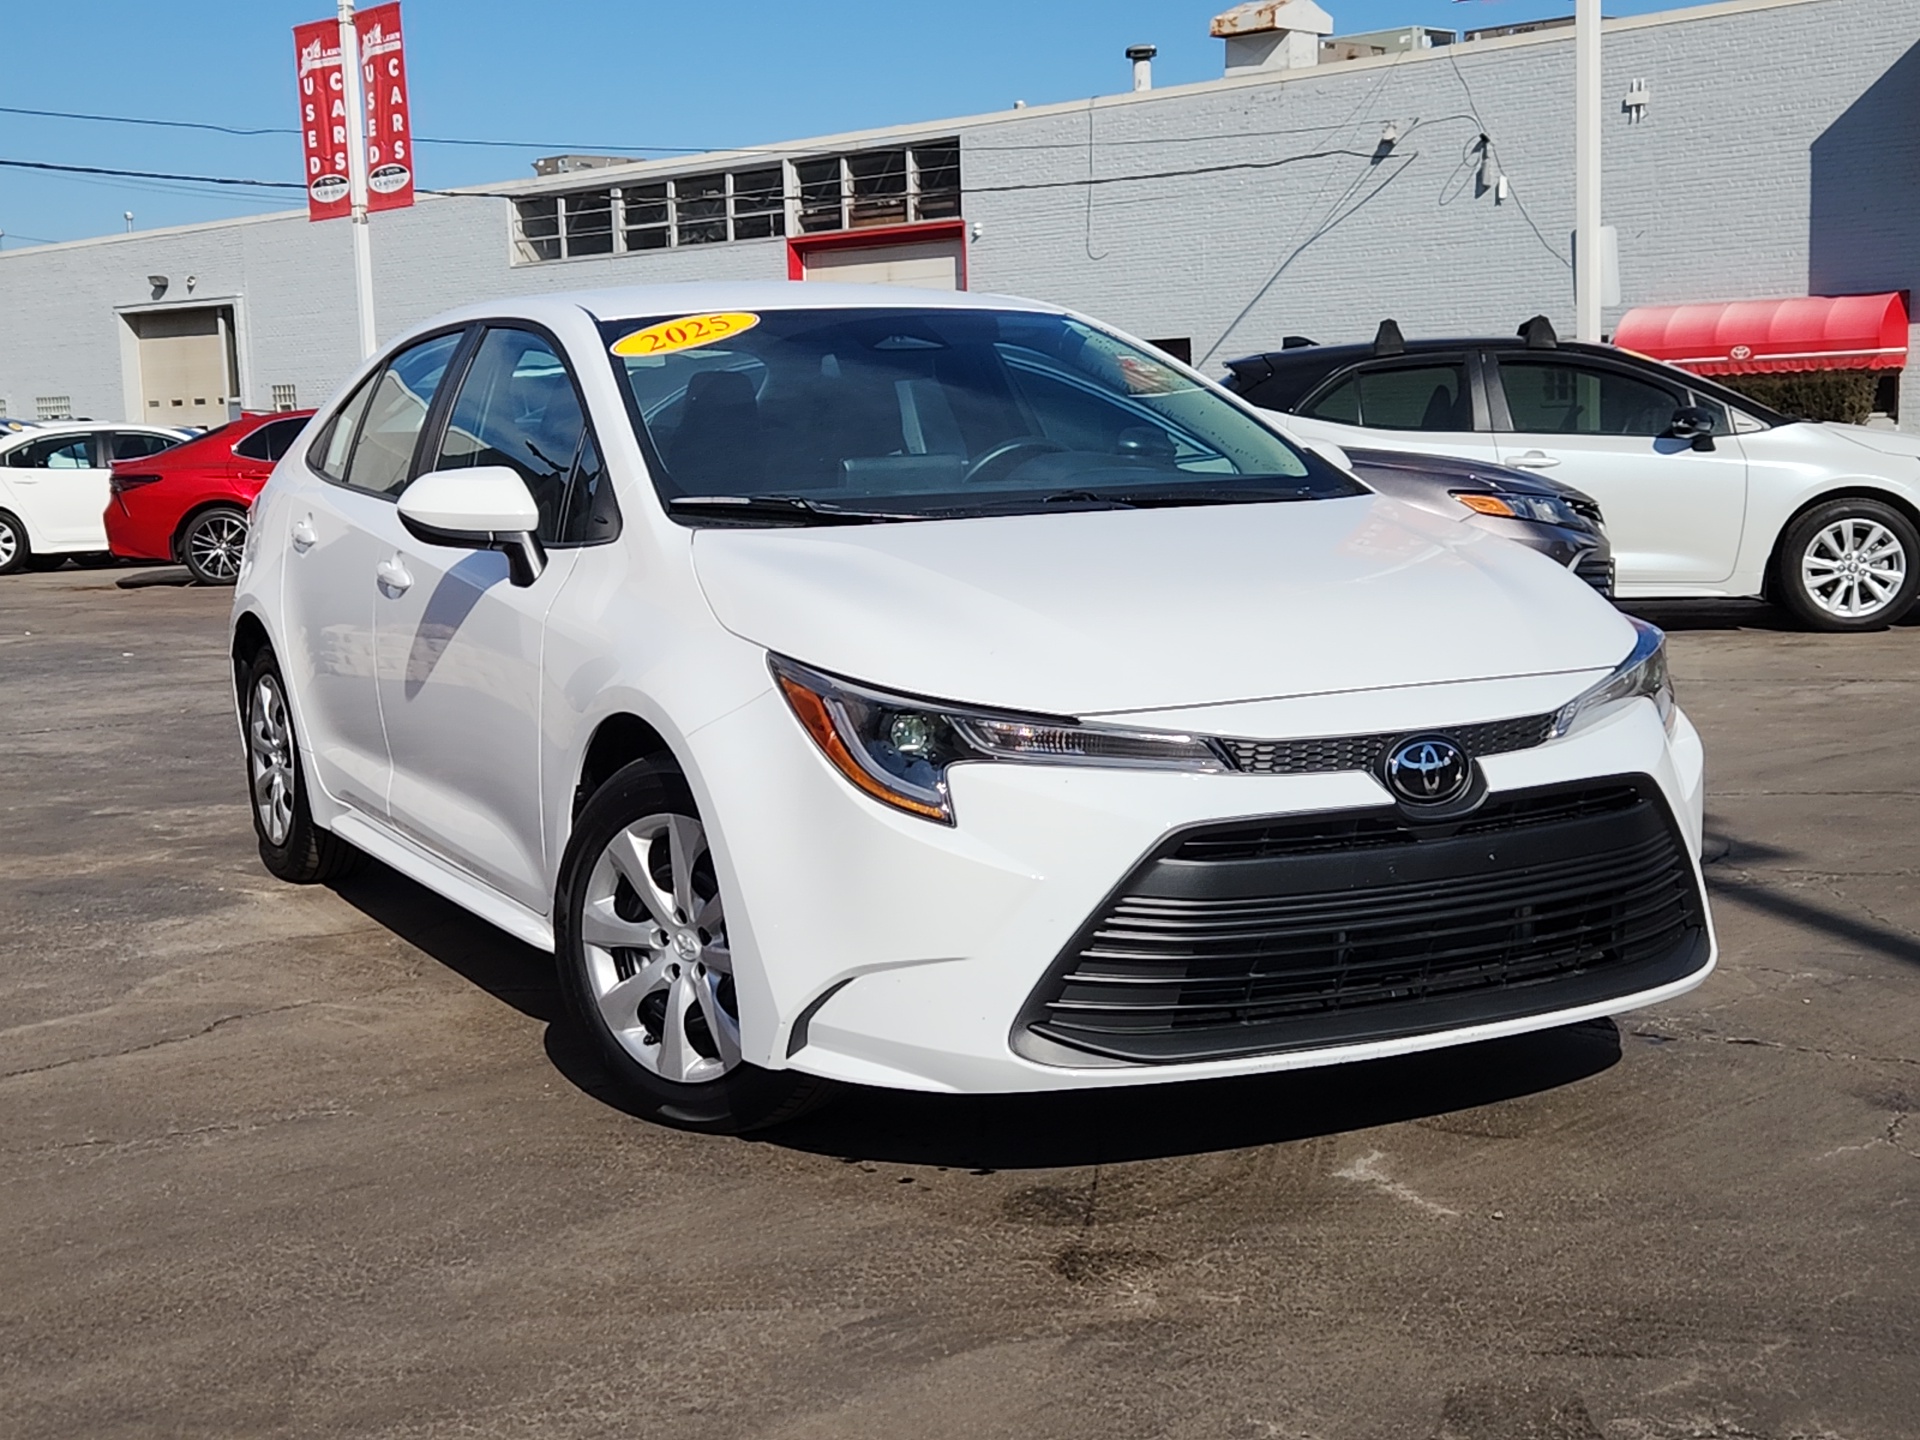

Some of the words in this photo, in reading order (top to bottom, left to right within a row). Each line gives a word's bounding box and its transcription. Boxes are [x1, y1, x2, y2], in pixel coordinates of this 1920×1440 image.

[303, 77, 320, 175] USED
[329, 72, 346, 171] CARS
[364, 64, 380, 164] USED
[388, 58, 405, 160] CARS
[640, 315, 730, 352] 2025
